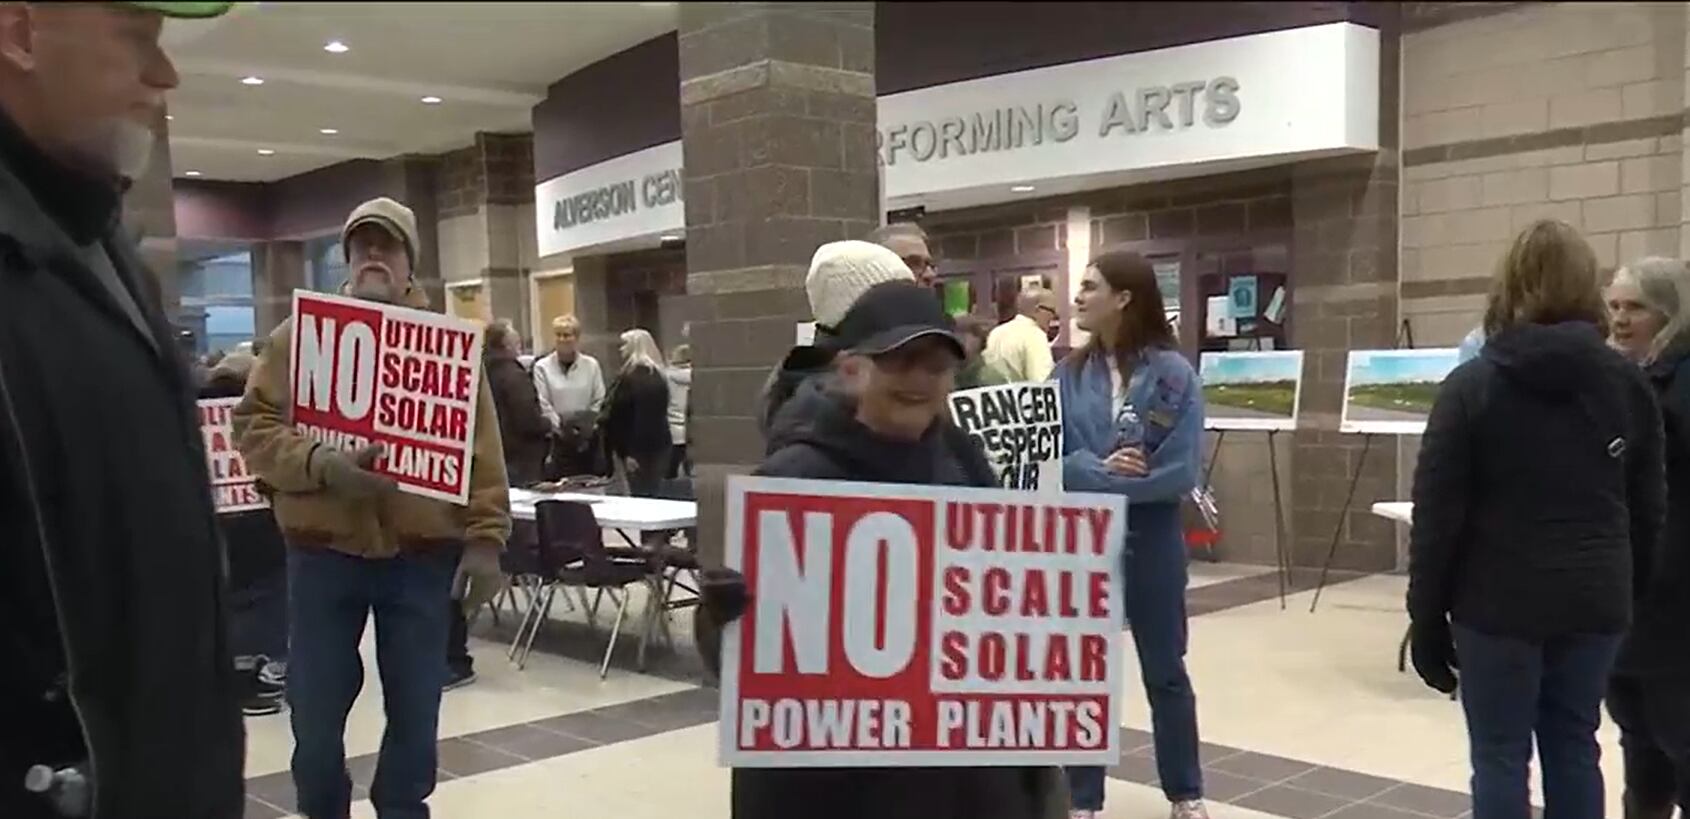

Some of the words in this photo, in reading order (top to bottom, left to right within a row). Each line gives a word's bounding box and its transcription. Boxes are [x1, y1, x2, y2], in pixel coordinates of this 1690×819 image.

[1099, 75, 1241, 138] ARTS
[554, 180, 636, 231] ALVERSON
[385, 318, 476, 361] UTILITY
[297, 313, 377, 421] NO
[382, 352, 472, 402] SCALE
[379, 393, 469, 441] SOLAR
[953, 386, 1058, 432] RANGER
[374, 439, 460, 486] PLANTS
[945, 502, 1112, 555] UTILITY
[754, 510, 919, 678] NO
[942, 566, 1111, 618] SCALE
[941, 631, 1108, 682] SOLAR
[740, 699, 911, 748] POWER
[937, 700, 1102, 748] PLANTS
